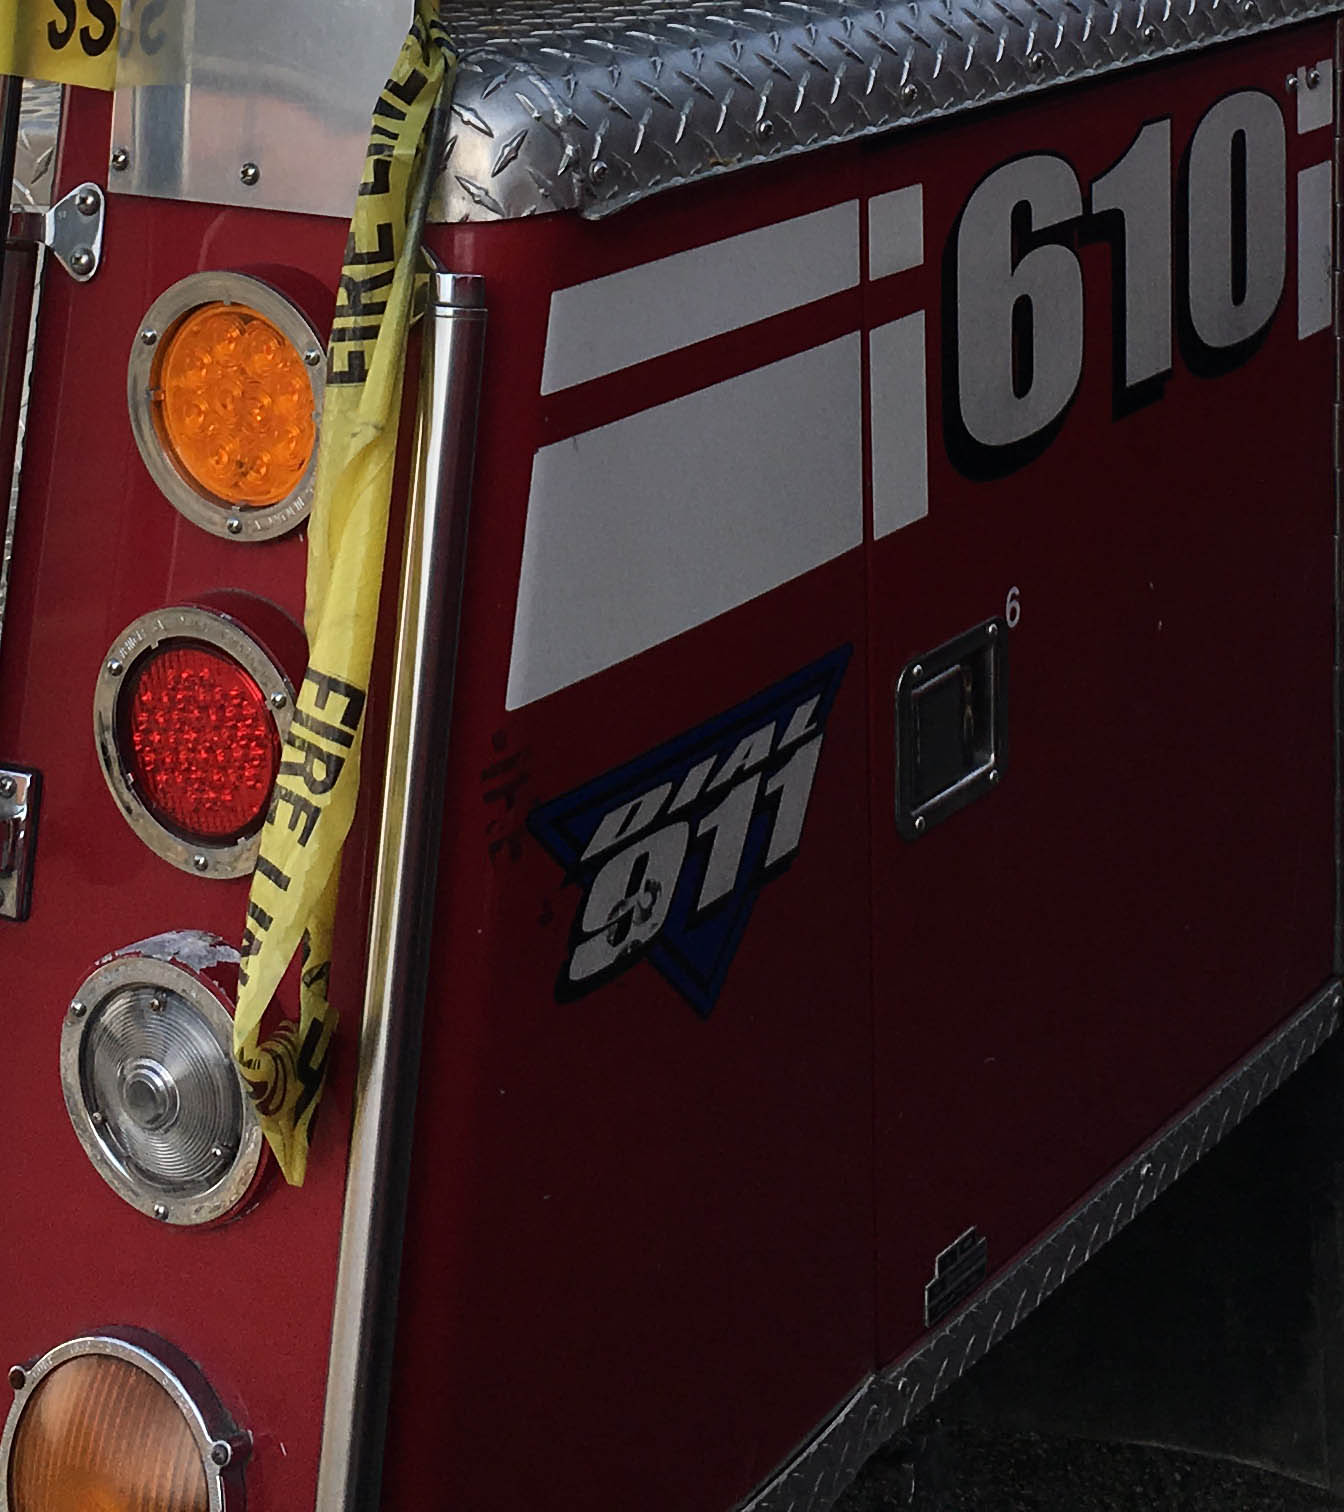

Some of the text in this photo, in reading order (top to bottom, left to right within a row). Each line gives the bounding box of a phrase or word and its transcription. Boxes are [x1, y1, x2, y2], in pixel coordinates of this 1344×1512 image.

[952, 89, 1288, 453] 610
[1006, 585, 1021, 628] 6
[261, 666, 365, 848] FIRE
[579, 693, 821, 862] DIAL
[567, 732, 824, 982] 911
